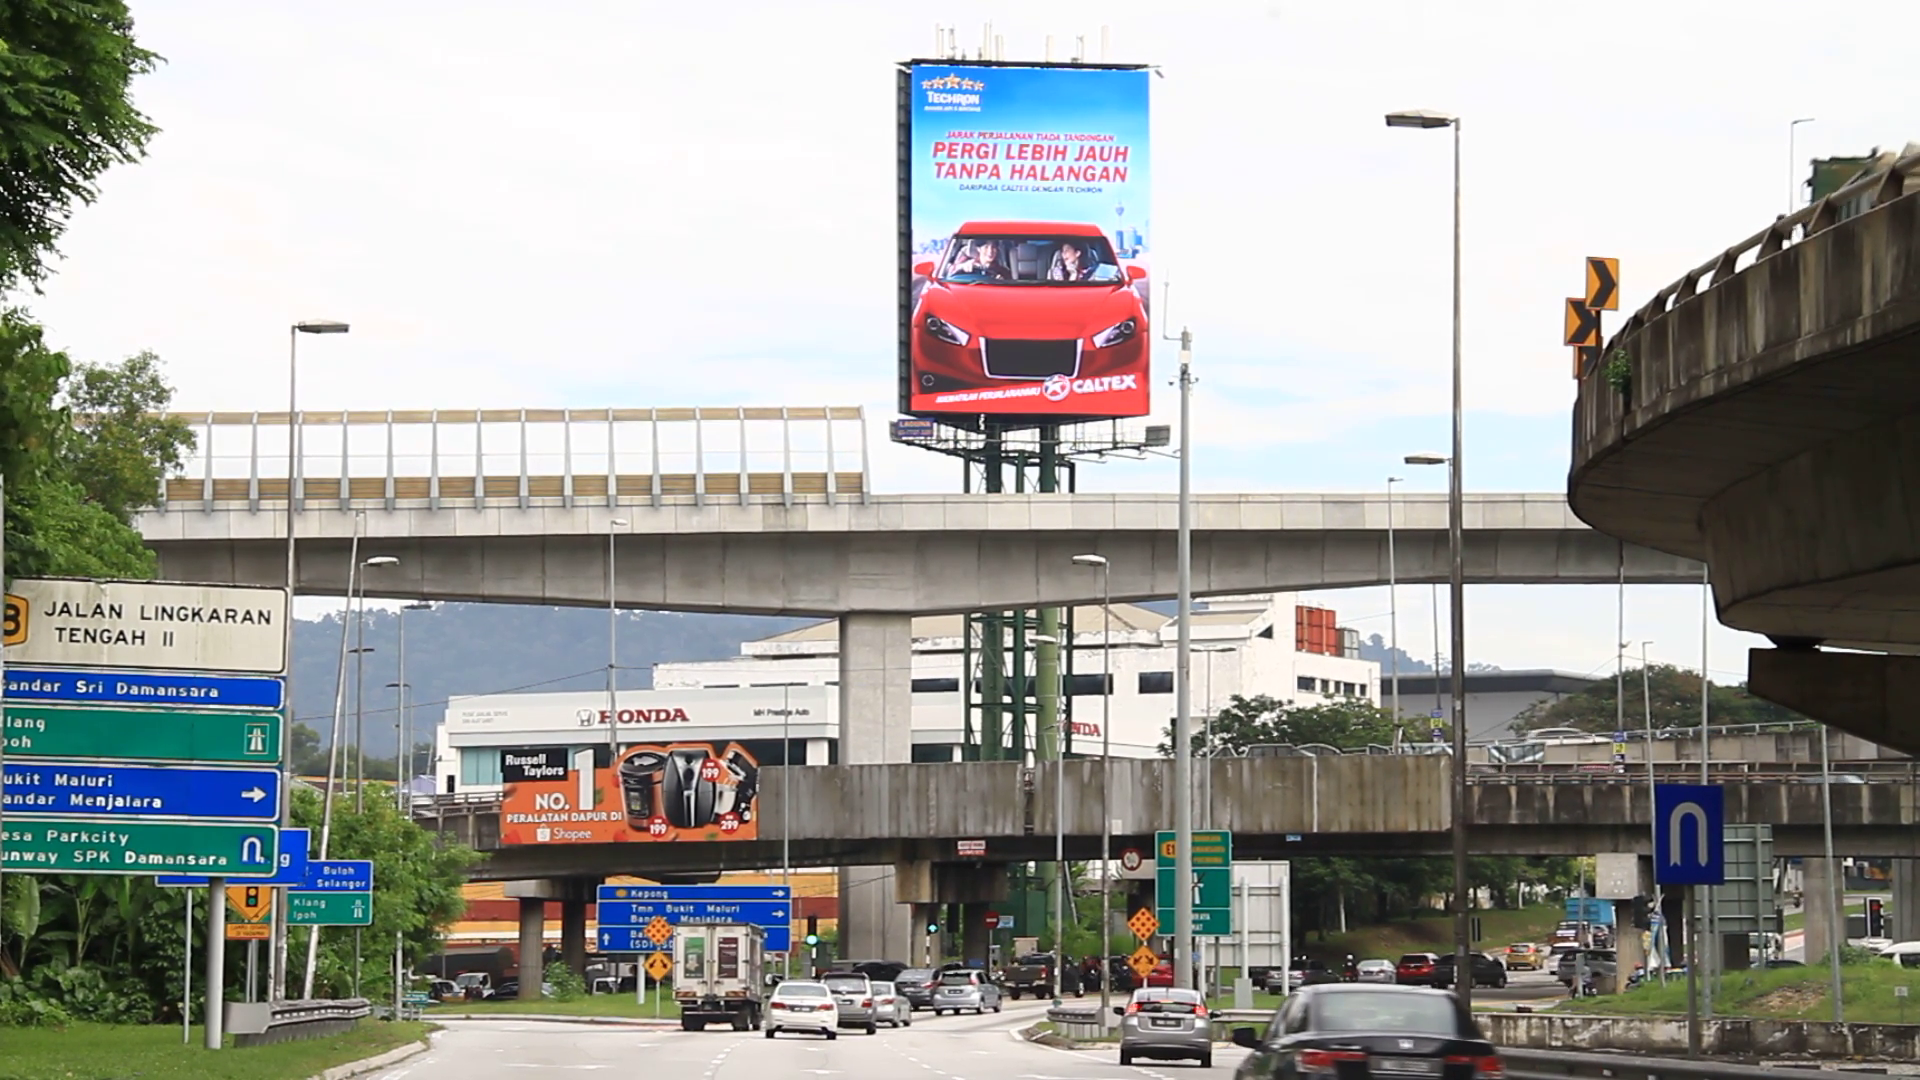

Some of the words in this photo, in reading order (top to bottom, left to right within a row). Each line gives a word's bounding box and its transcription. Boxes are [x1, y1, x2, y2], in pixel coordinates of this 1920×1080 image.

[926, 91, 981, 105] TECHRON
[932, 142, 998, 159] PERGI
[1005, 144, 1068, 161] LEBIH
[1074, 146, 1129, 162] JAUH
[935, 162, 1001, 179] TANPA
[1010, 164, 1128, 182] HALANGAN
[1072, 374, 1137, 394] CALTEX
[44, 601, 122, 620] JALAN
[139, 605, 272, 625] LINGKARAN
[55, 627, 146, 646] TENGAH
[76, 680, 103, 694] Sri
[116, 682, 220, 699] Damansara
[597, 708, 690, 724] HONDA
[6, 716, 46, 732] lang
[505, 753, 547, 766] Russell
[522, 765, 565, 778] Taylors
[701, 768, 719, 778] 199
[4, 772, 41, 785] ukit
[54, 773, 113, 788] Maluri
[535, 792, 570, 810] NO.
[573, 748, 594, 811] 1
[3, 793, 56, 805] andar
[69, 793, 163, 811] Menjalara
[506, 812, 568, 823] PERALATAN
[571, 811, 607, 821] DAPUR
[610, 811, 622, 820] DI
[650, 824, 667, 834] 199
[720, 820, 738, 830] 299
[2, 831, 33, 842] esa
[46, 829, 130, 846] Parkcity
[552, 827, 592, 841] Shopee
[2, 850, 59, 865] unway
[73, 849, 111, 863] SPK
[124, 850, 228, 866] Damansara
[323, 866, 355, 875] Buloh
[316, 879, 366, 889] Selangor
[630, 890, 668, 899] Kepong
[294, 899, 326, 909] Klang
[631, 905, 653, 913] Tmn
[666, 905, 695, 913] Bukit
[707, 905, 740, 913] Maluri
[294, 912, 317, 921] Ipoh
